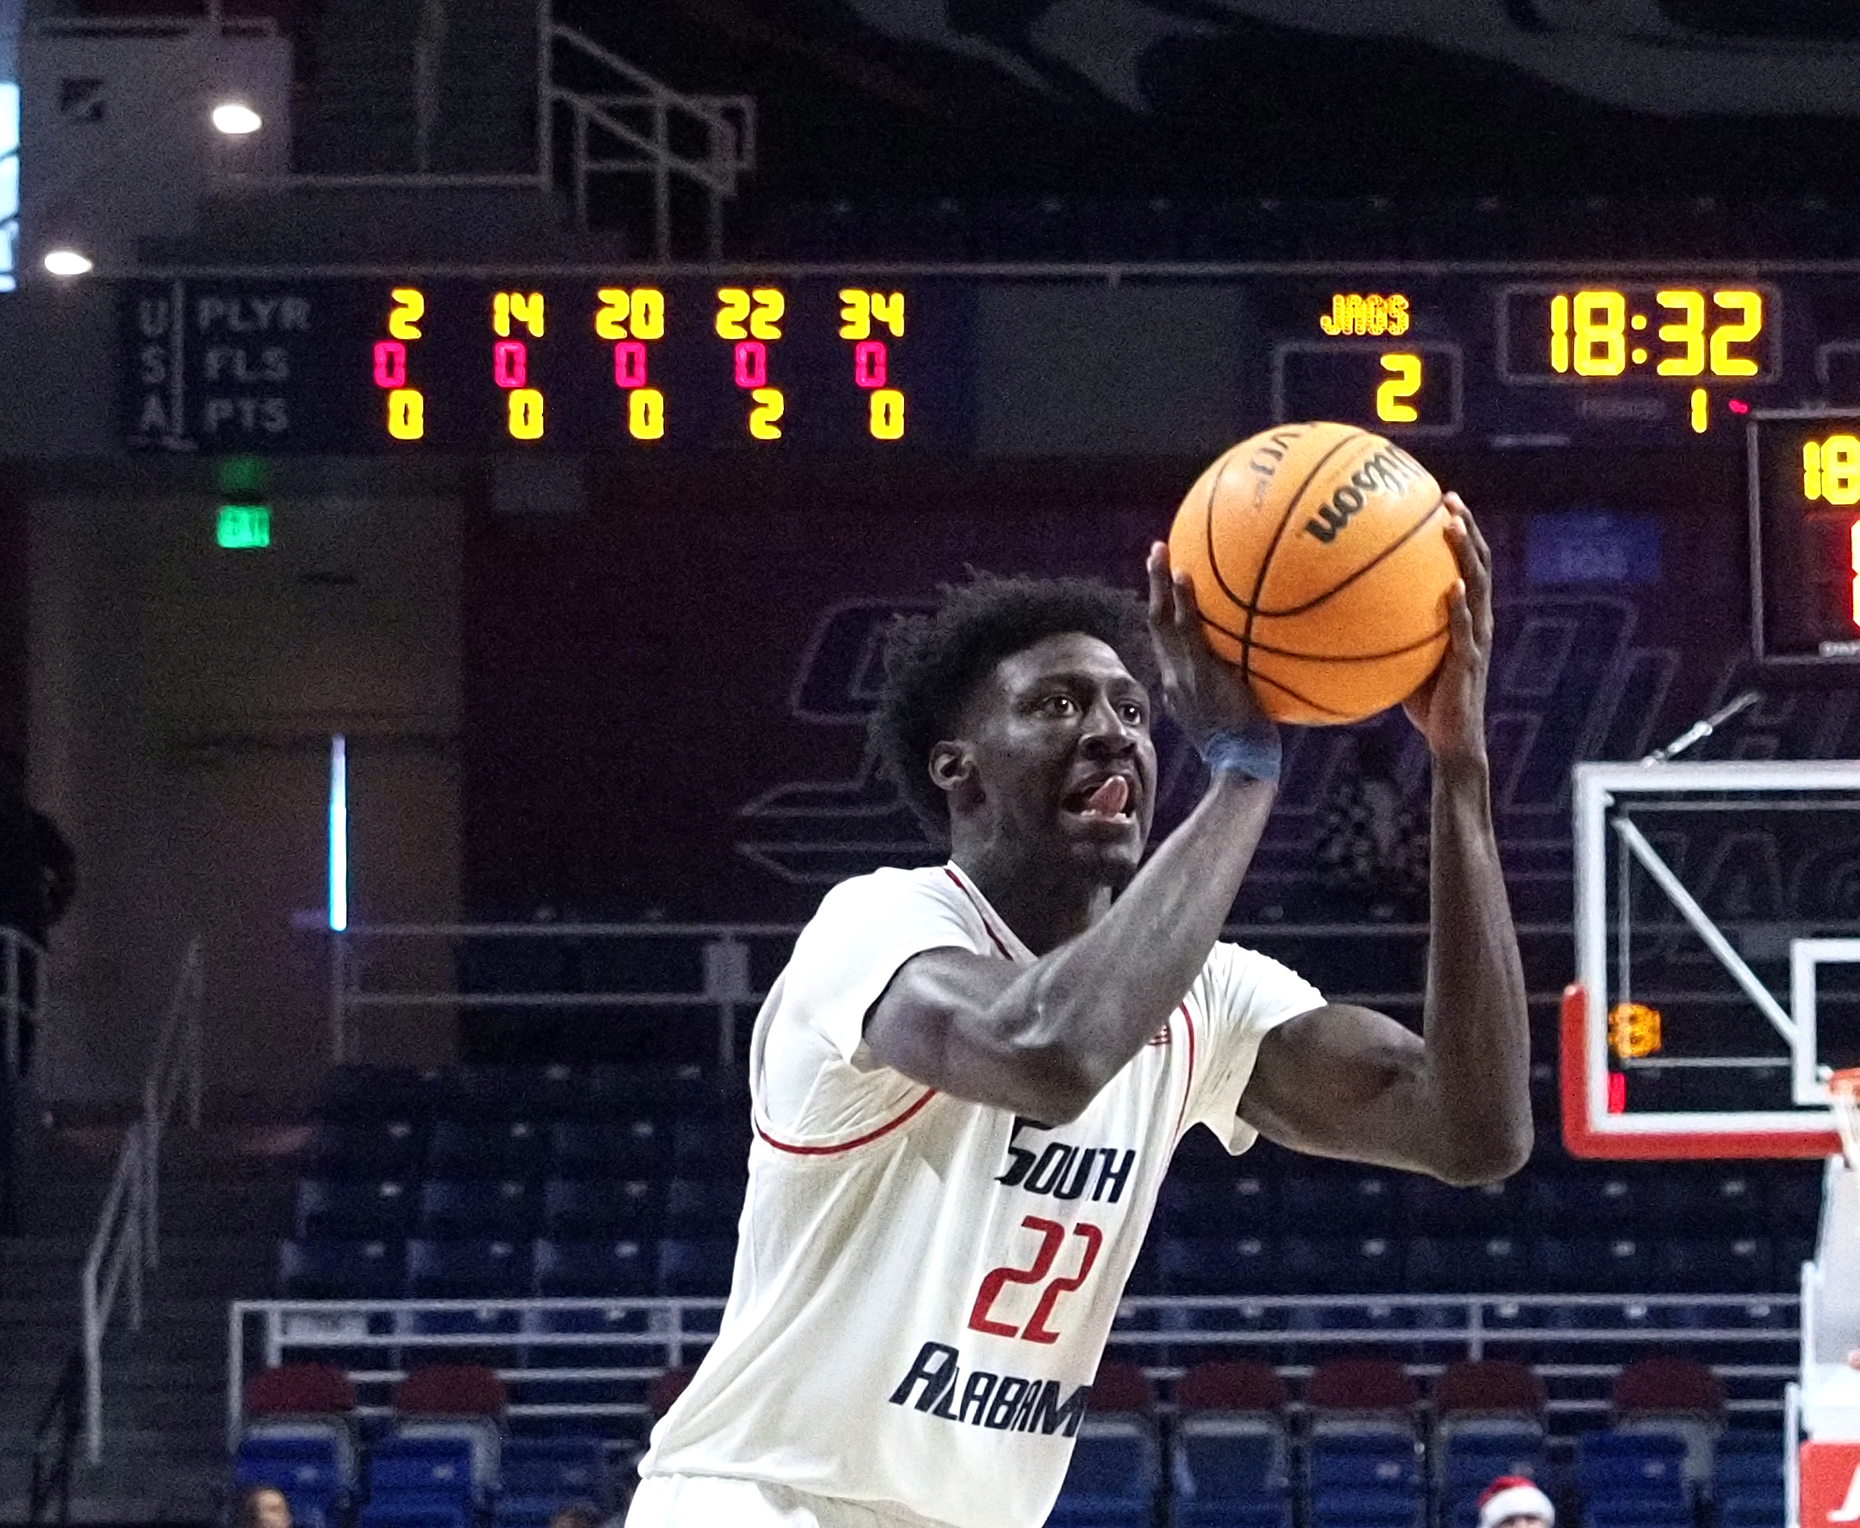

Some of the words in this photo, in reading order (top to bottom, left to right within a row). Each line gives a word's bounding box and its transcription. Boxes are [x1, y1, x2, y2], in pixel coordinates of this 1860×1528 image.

[197, 296, 311, 331] PLYR
[388, 288, 425, 339] 2
[492, 291, 545, 338] 14
[595, 288, 665, 339] 20
[715, 288, 785, 340] 22
[839, 288, 905, 339] 34
[1319, 293, 1410, 336] JAGS
[1550, 287, 1763, 377] 18:32
[204, 345, 290, 383] FLS
[373, 341, 406, 388] 0
[493, 341, 527, 388] 0
[614, 341, 647, 388] 0
[734, 341, 767, 388] 0
[855, 341, 887, 388] 0
[1376, 352, 1421, 423] 2
[204, 397, 289, 434] PTS
[387, 388, 425, 440] 0
[508, 388, 545, 440] 0
[629, 388, 665, 440] 0
[749, 388, 785, 440] 2
[870, 388, 905, 440] 0
[1690, 387, 1708, 434] 1
[967, 1214, 1104, 1345] 22
[888, 1340, 1094, 1438] ALABAM
